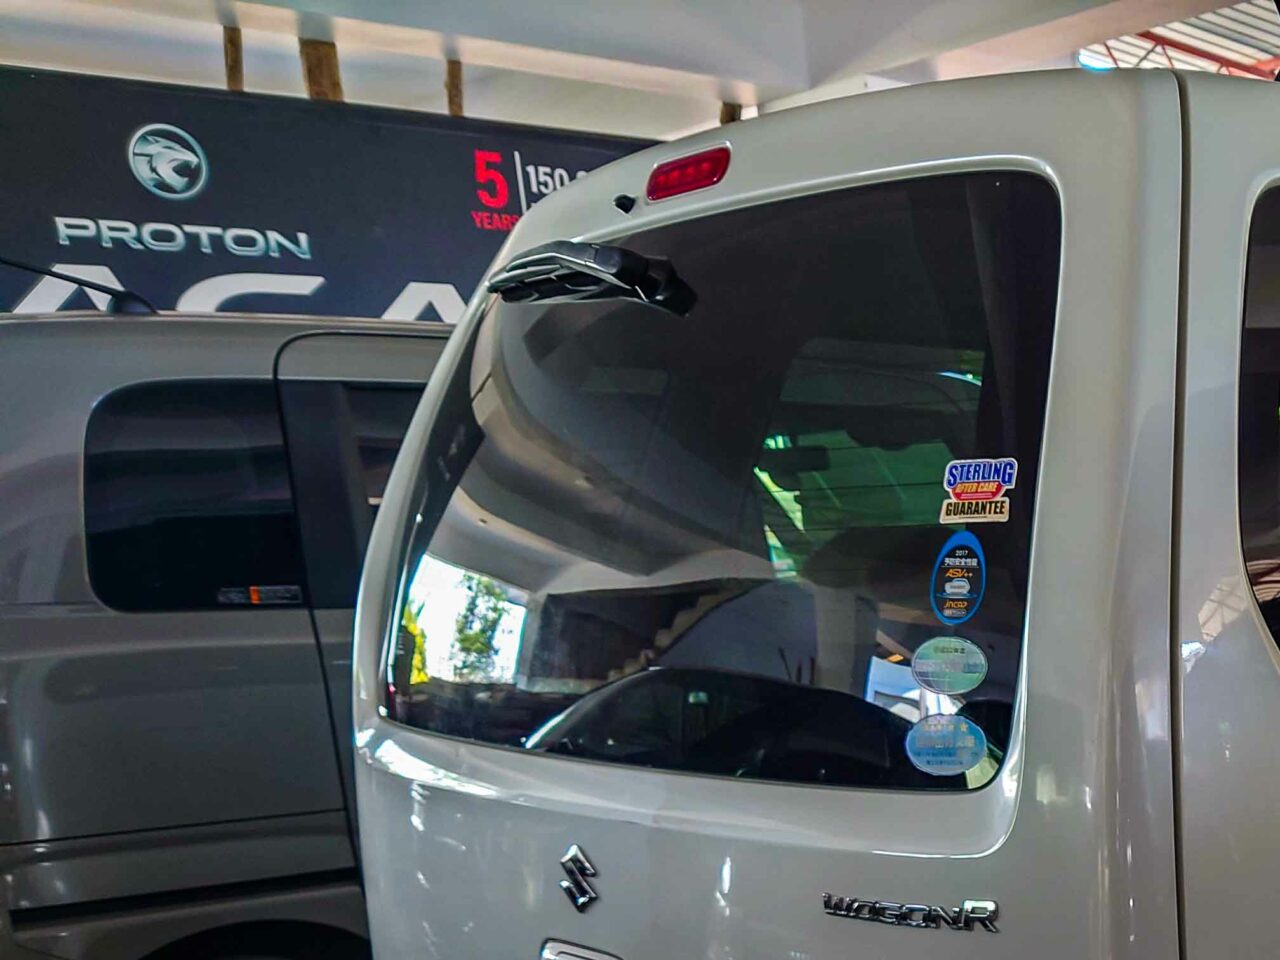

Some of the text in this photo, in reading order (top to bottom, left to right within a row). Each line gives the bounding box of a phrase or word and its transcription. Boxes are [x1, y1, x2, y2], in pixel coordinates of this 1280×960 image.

[474, 149, 509, 209] 5
[54, 216, 311, 260] PROTON
[947, 462, 1014, 487] STERLING
[945, 501, 1006, 516] GUARANTEE
